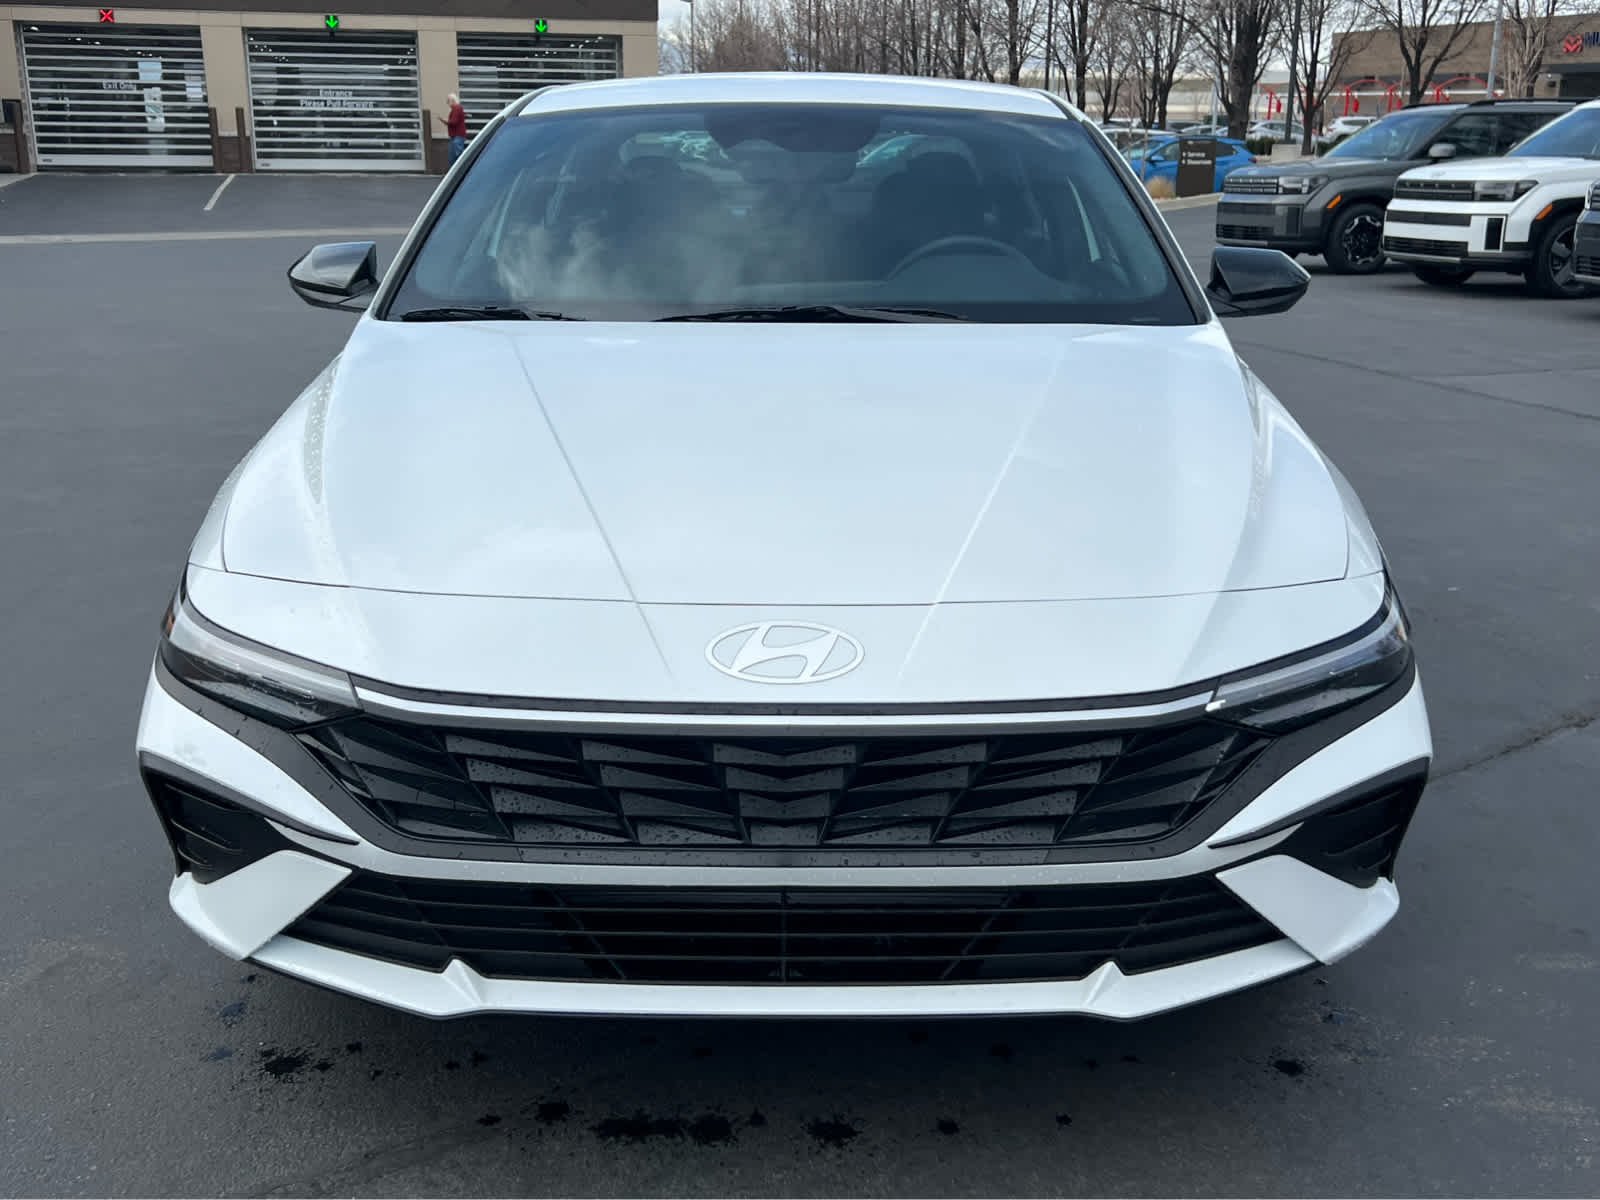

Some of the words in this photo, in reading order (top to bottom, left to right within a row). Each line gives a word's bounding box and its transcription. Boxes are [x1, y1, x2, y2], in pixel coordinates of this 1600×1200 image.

[102, 80, 117, 90] Exit
[319, 89, 353, 98] Entrance
[300, 99, 324, 108] Please
